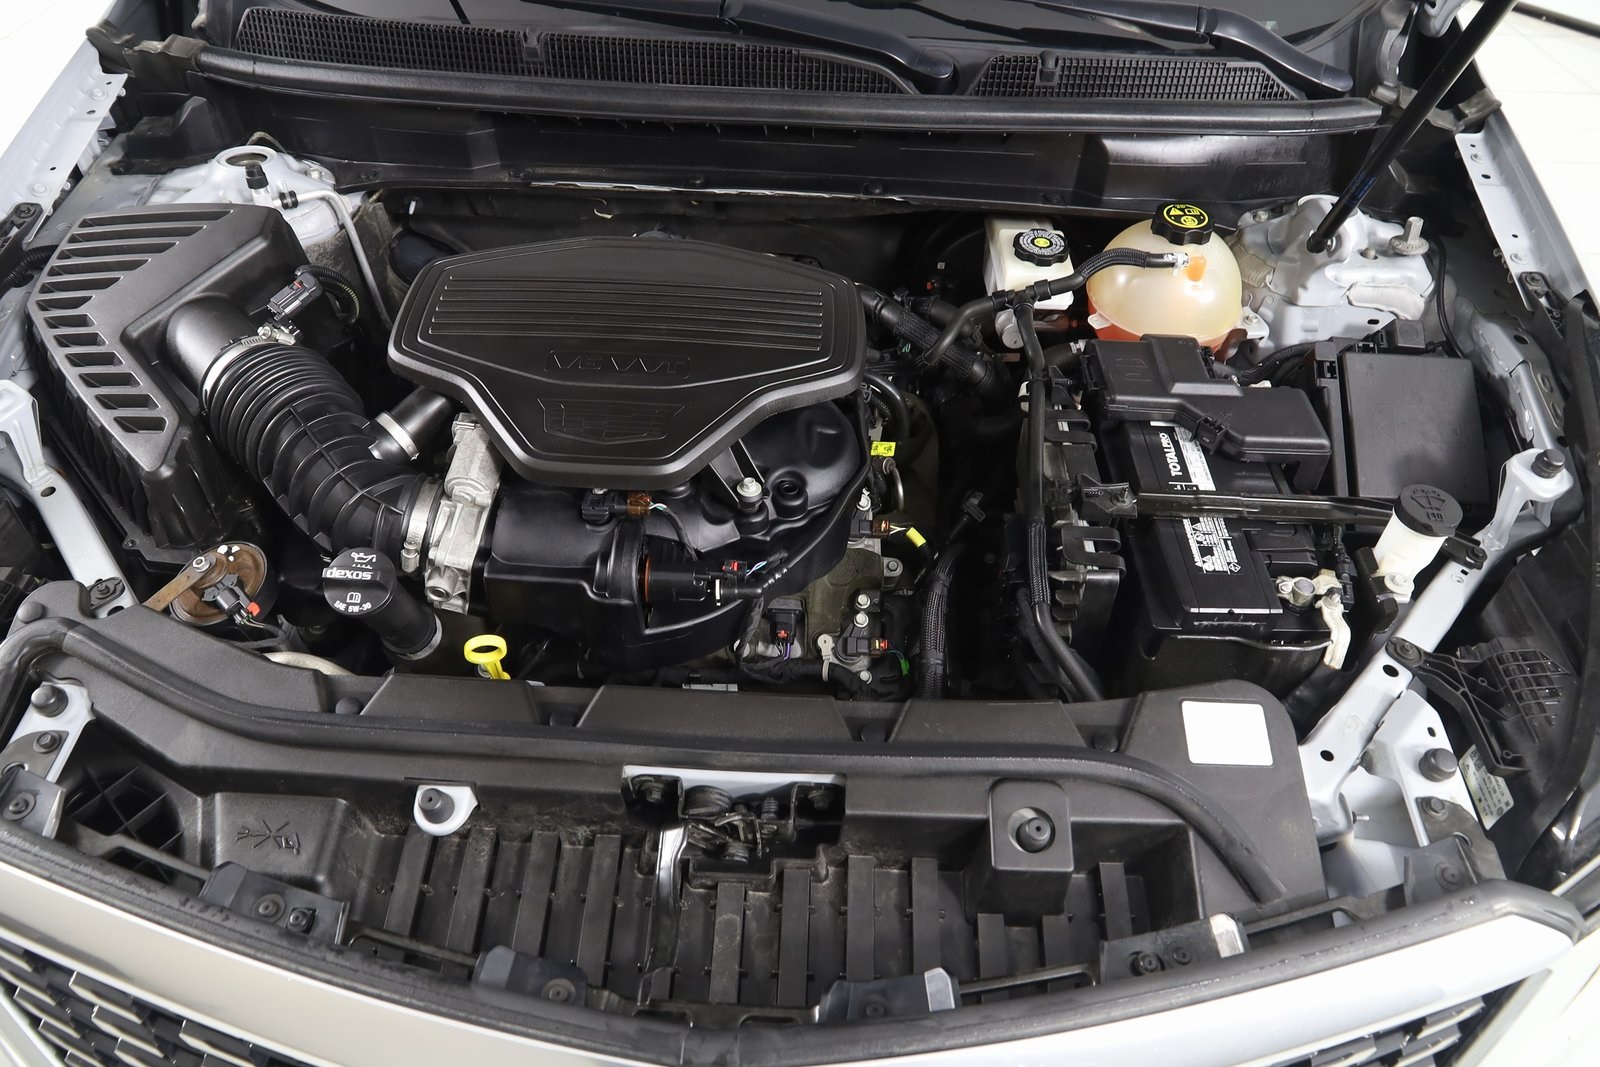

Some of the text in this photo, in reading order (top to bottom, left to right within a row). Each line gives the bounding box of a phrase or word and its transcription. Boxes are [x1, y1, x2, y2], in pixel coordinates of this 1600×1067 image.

[326, 567, 373, 580] dexos
[334, 600, 372, 613] SAE 5W-30
